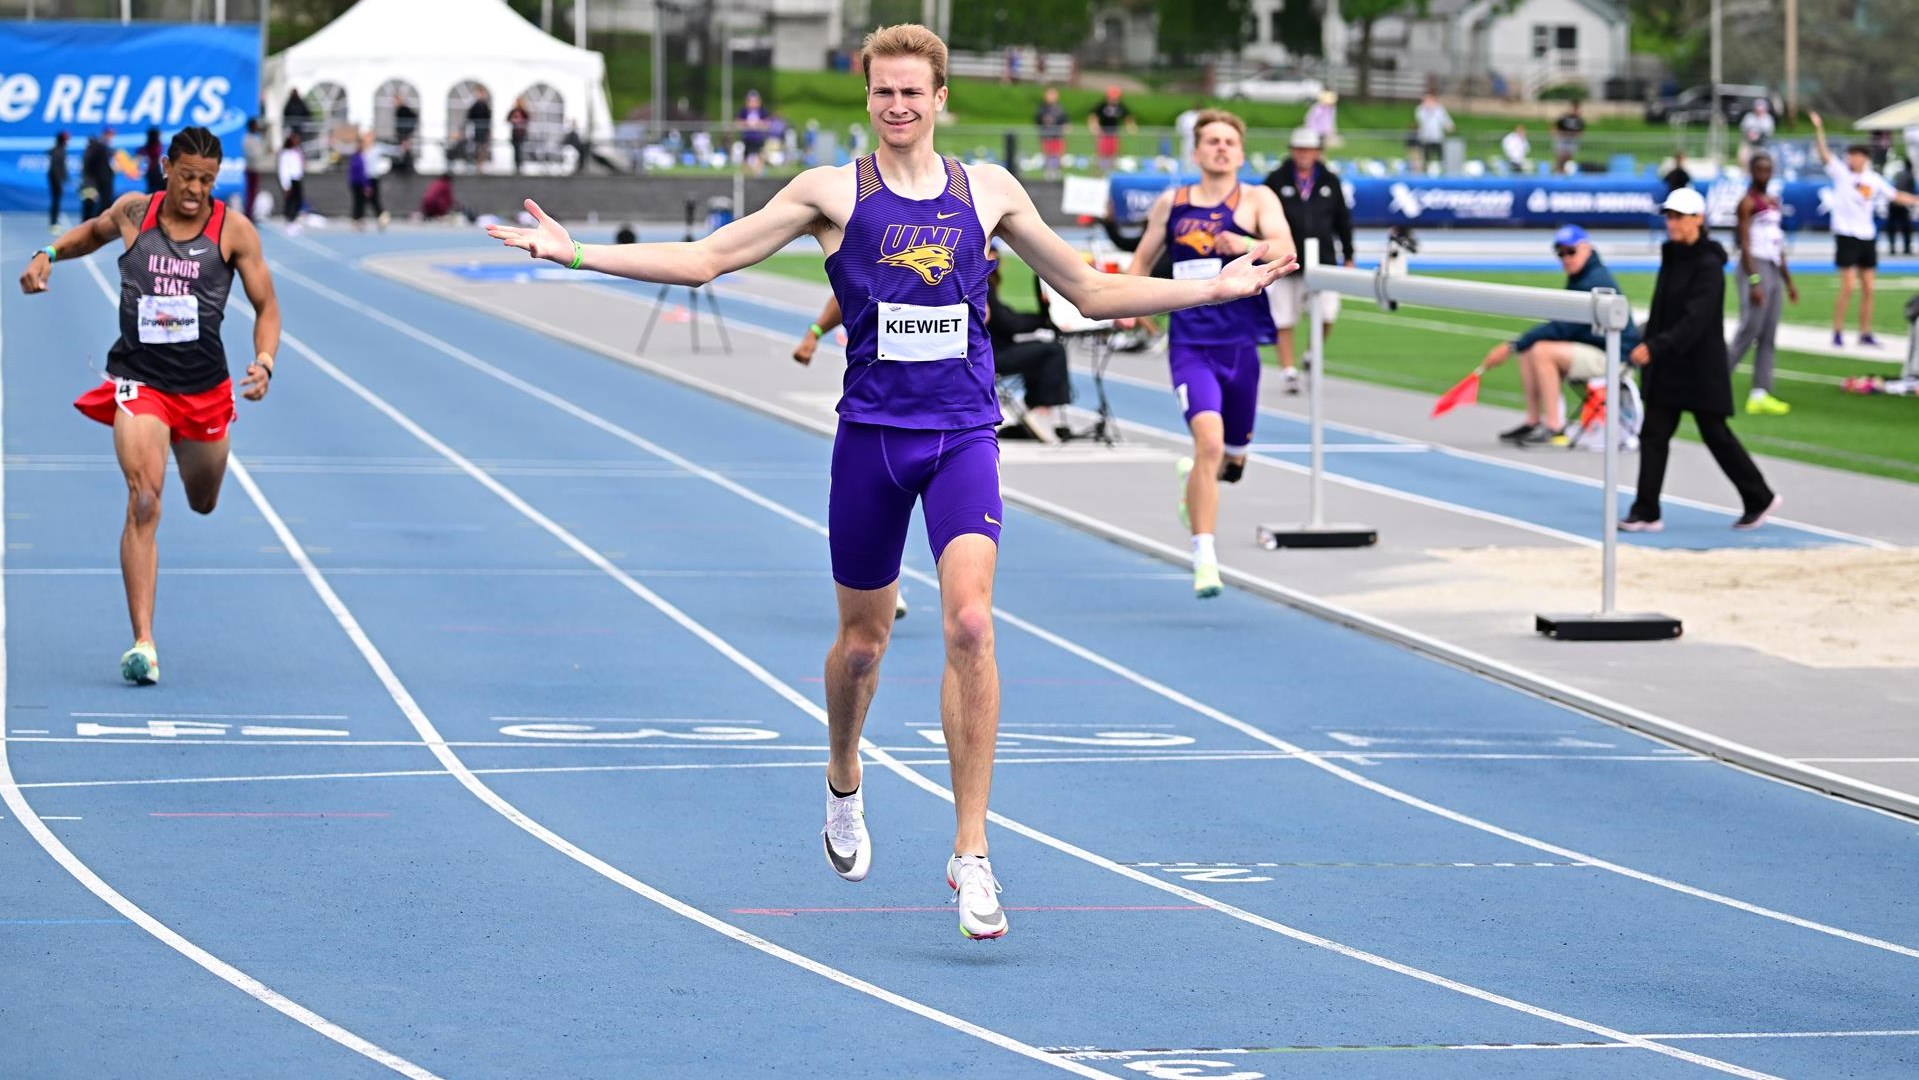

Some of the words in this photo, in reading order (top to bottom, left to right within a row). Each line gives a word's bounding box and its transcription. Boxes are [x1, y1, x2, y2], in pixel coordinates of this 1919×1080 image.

[0, 72, 40, 122] e
[43, 74, 231, 125] RELAYS
[880, 224, 962, 257] UNI
[148, 254, 200, 279] ILLINOIS
[154, 276, 191, 296] STATE
[886, 318, 962, 334] KIEWIET
[119, 384, 131, 397] 4
